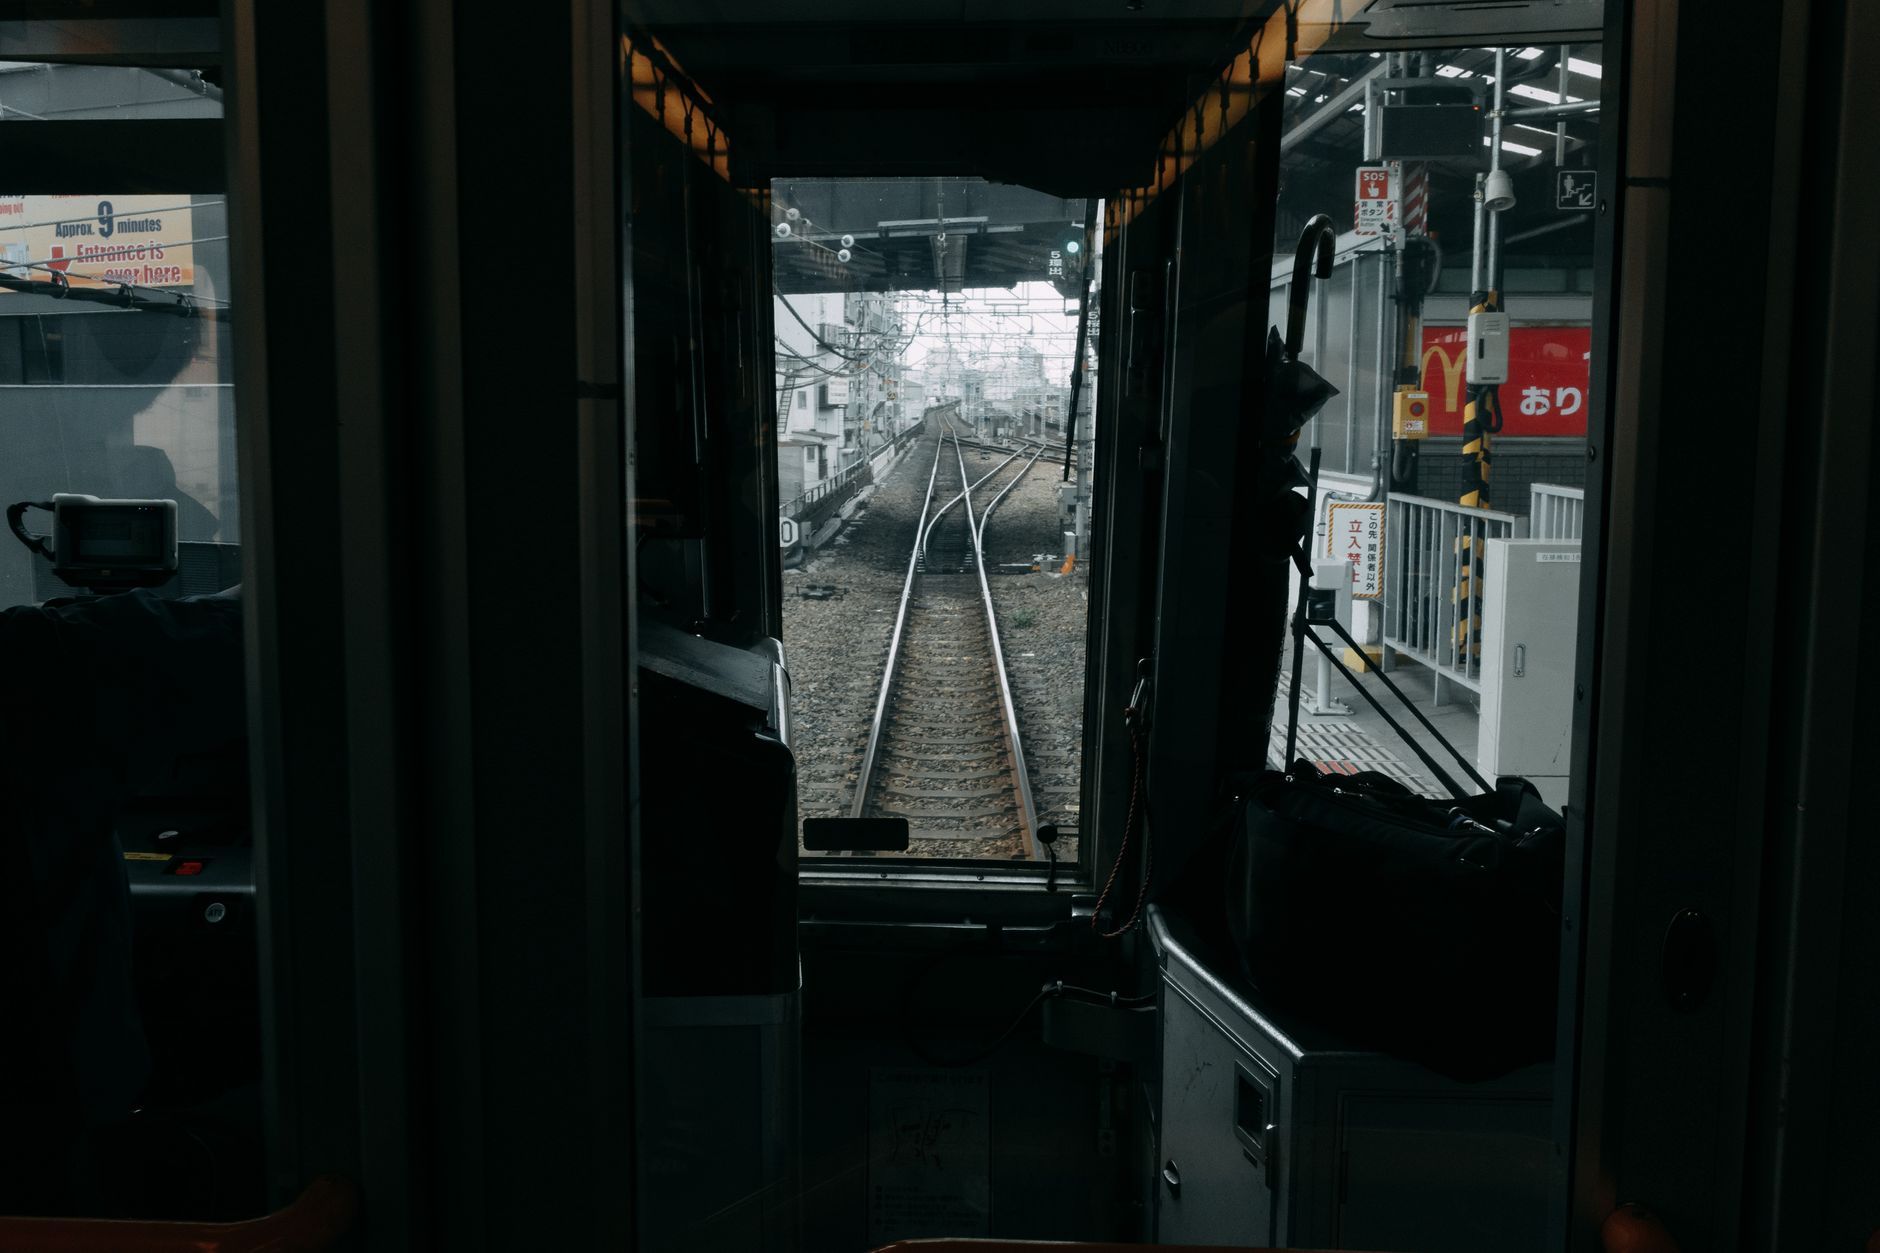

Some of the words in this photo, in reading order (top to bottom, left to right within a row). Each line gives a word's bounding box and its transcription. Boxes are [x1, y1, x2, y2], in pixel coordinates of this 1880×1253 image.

[1363, 172, 1385, 181] SOS
[55, 223, 95, 238] Approx.
[97, 200, 114, 238] 9
[117, 218, 162, 234] minutes
[77, 244, 146, 263] Entrance
[149, 241, 165, 261] is
[105, 267, 140, 285] over
[143, 264, 181, 284] here
[1520, 386, 1582, 416] おり
[1368, 512, 1378, 539] この先
[1366, 543, 1377, 591] 関係者以外
